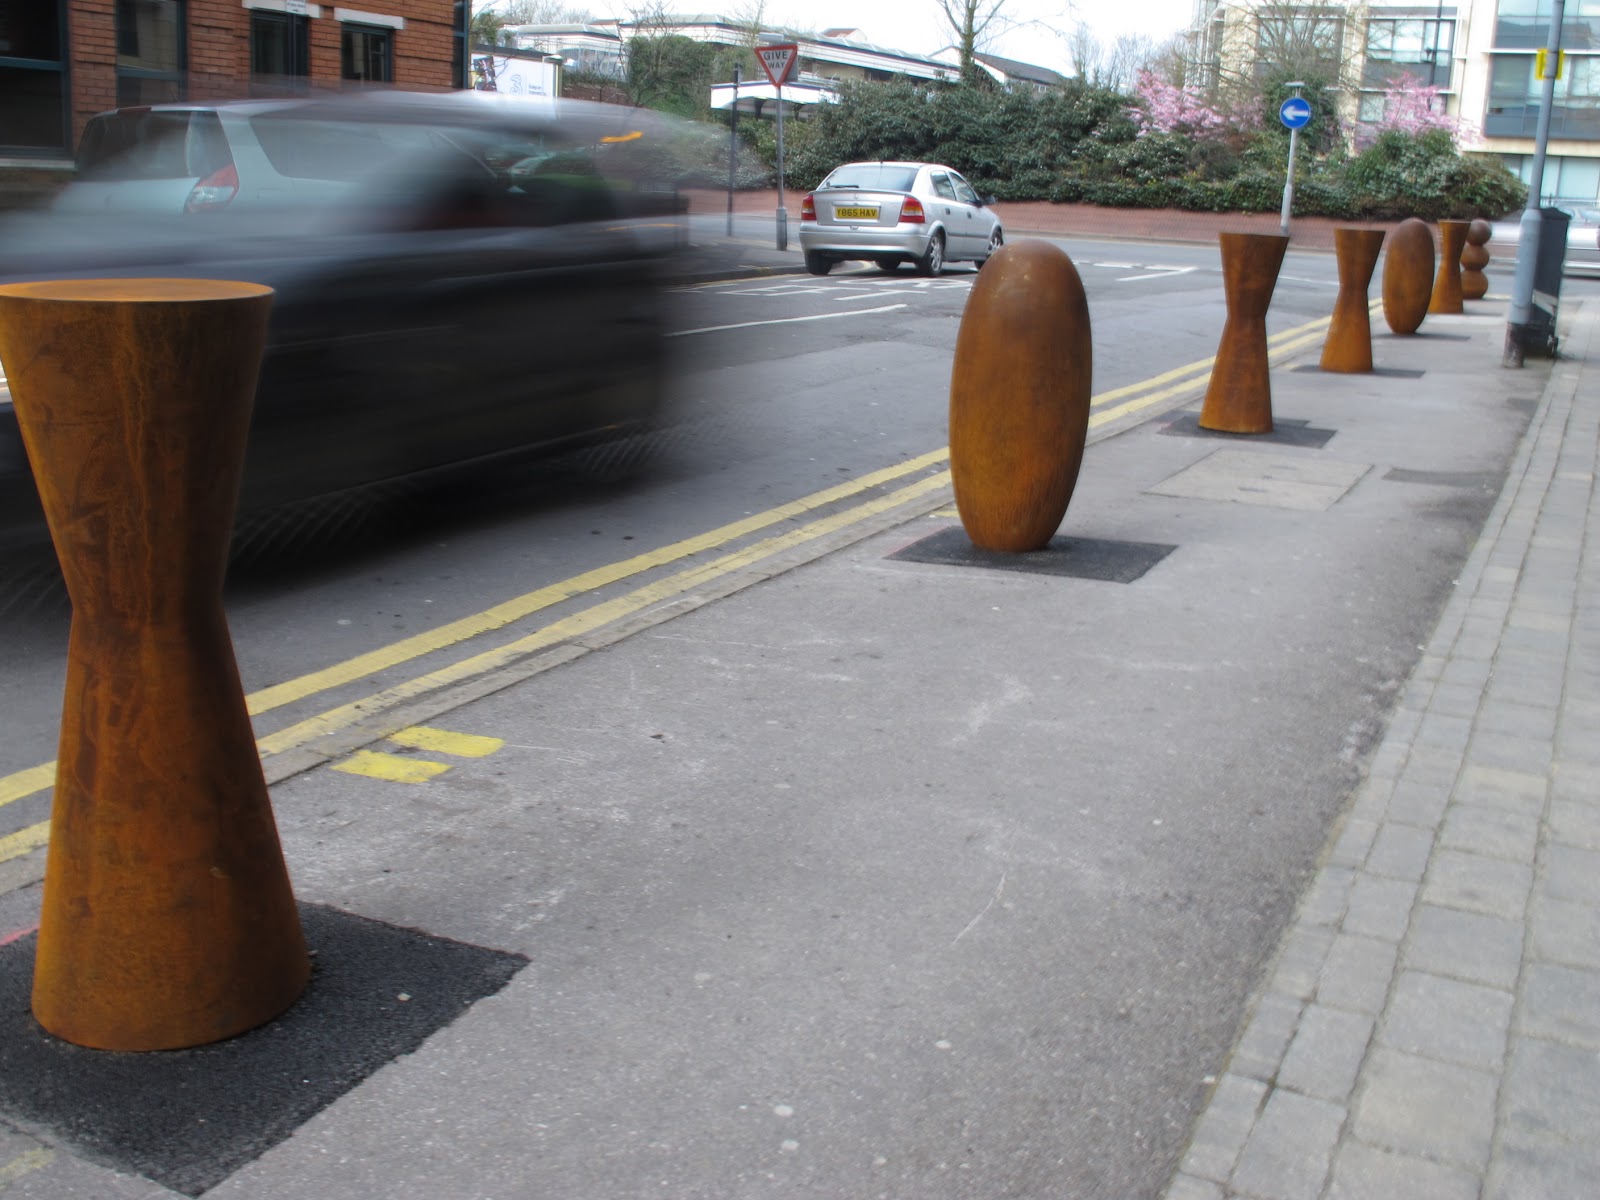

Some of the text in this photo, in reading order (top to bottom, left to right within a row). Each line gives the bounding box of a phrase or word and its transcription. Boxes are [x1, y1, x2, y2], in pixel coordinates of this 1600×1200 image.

[763, 51, 788, 60] GIVE
[768, 61, 785, 69] WAY
[836, 208, 877, 217] Y865 HAV
